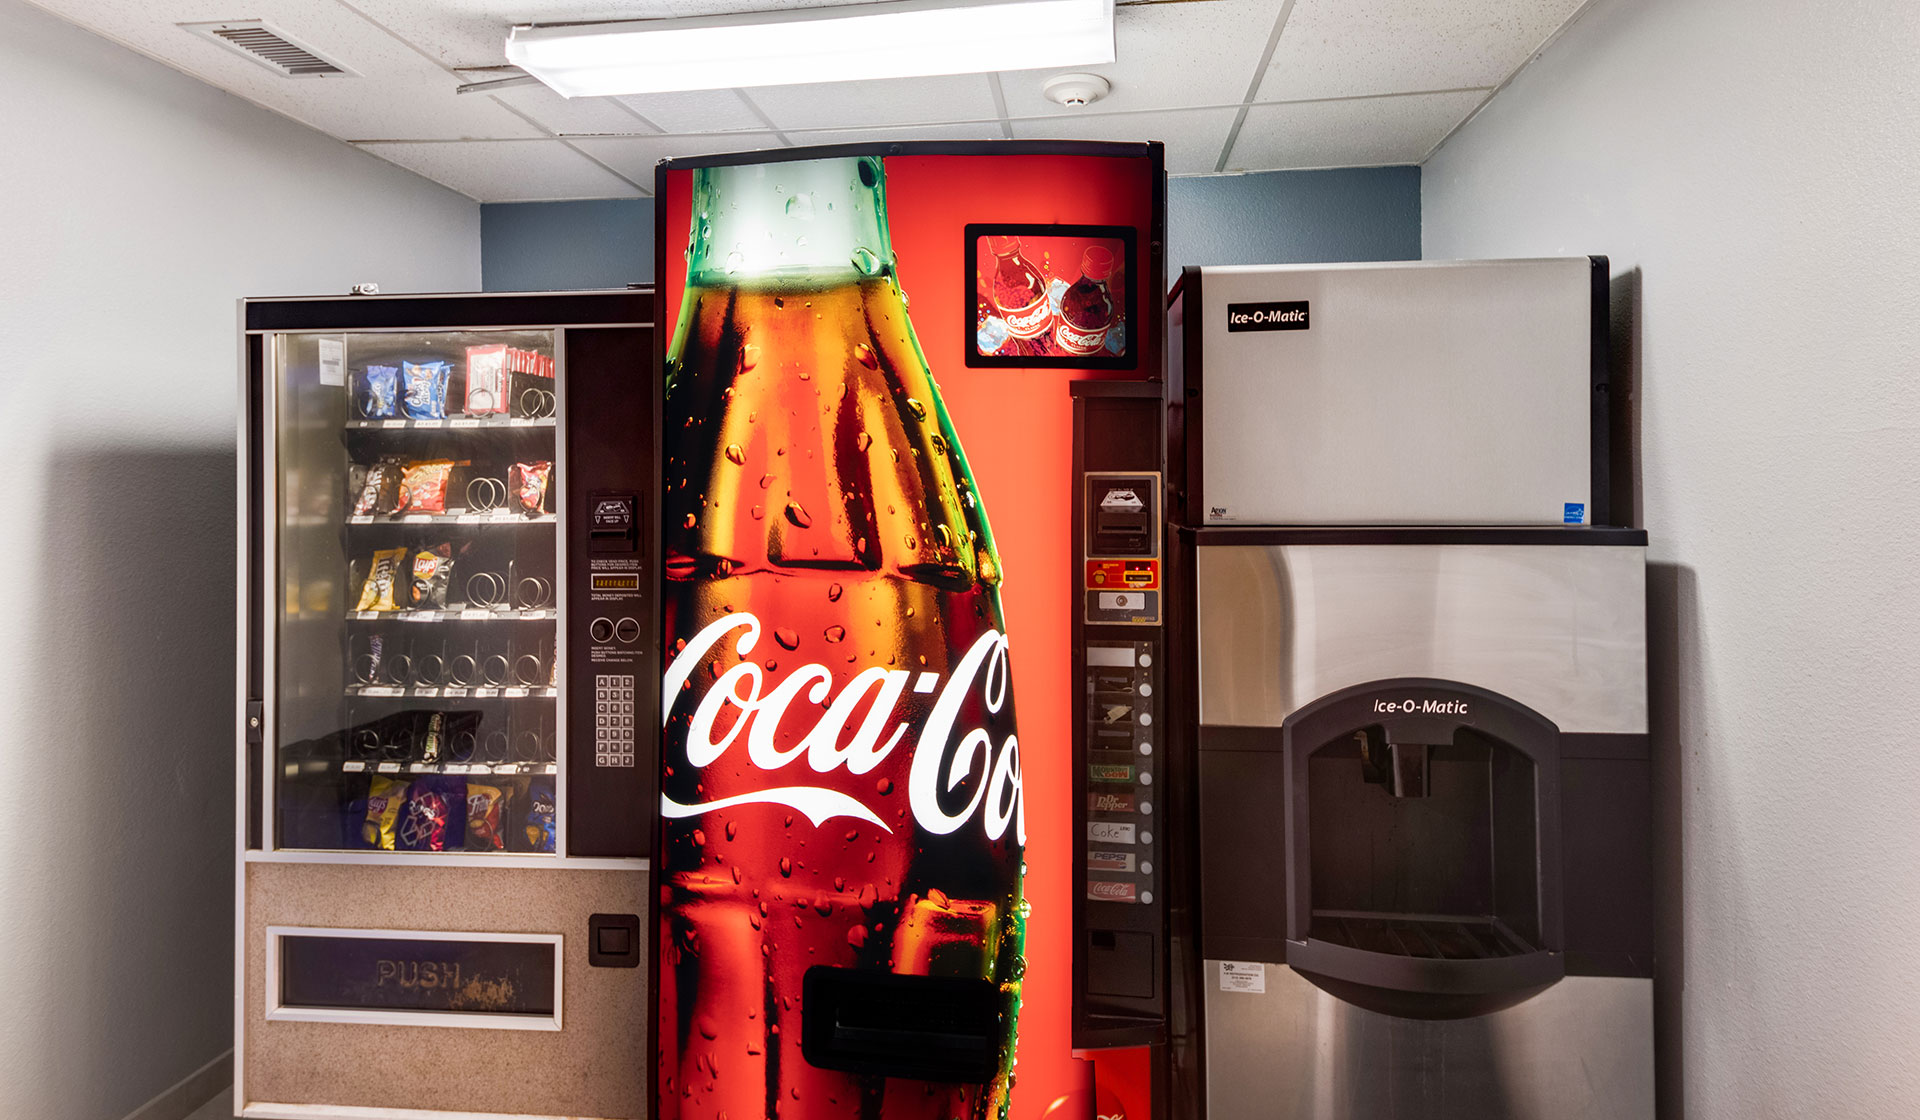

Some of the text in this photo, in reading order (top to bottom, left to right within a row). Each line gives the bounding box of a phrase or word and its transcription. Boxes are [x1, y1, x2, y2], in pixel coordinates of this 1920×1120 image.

[1229, 309, 1306, 324] Ice-O-Matic
[1373, 698, 1468, 714] Ice-O-Matic
[664, 612, 1026, 847] Coca-Co
[1096, 796, 1128, 811] Pepper
[1106, 794, 1119, 803] Dr
[1090, 823, 1120, 838] Coke
[1094, 852, 1127, 861] PEPSI
[1093, 882, 1129, 896] Coca-Cola
[376, 959, 461, 990] PUSH
